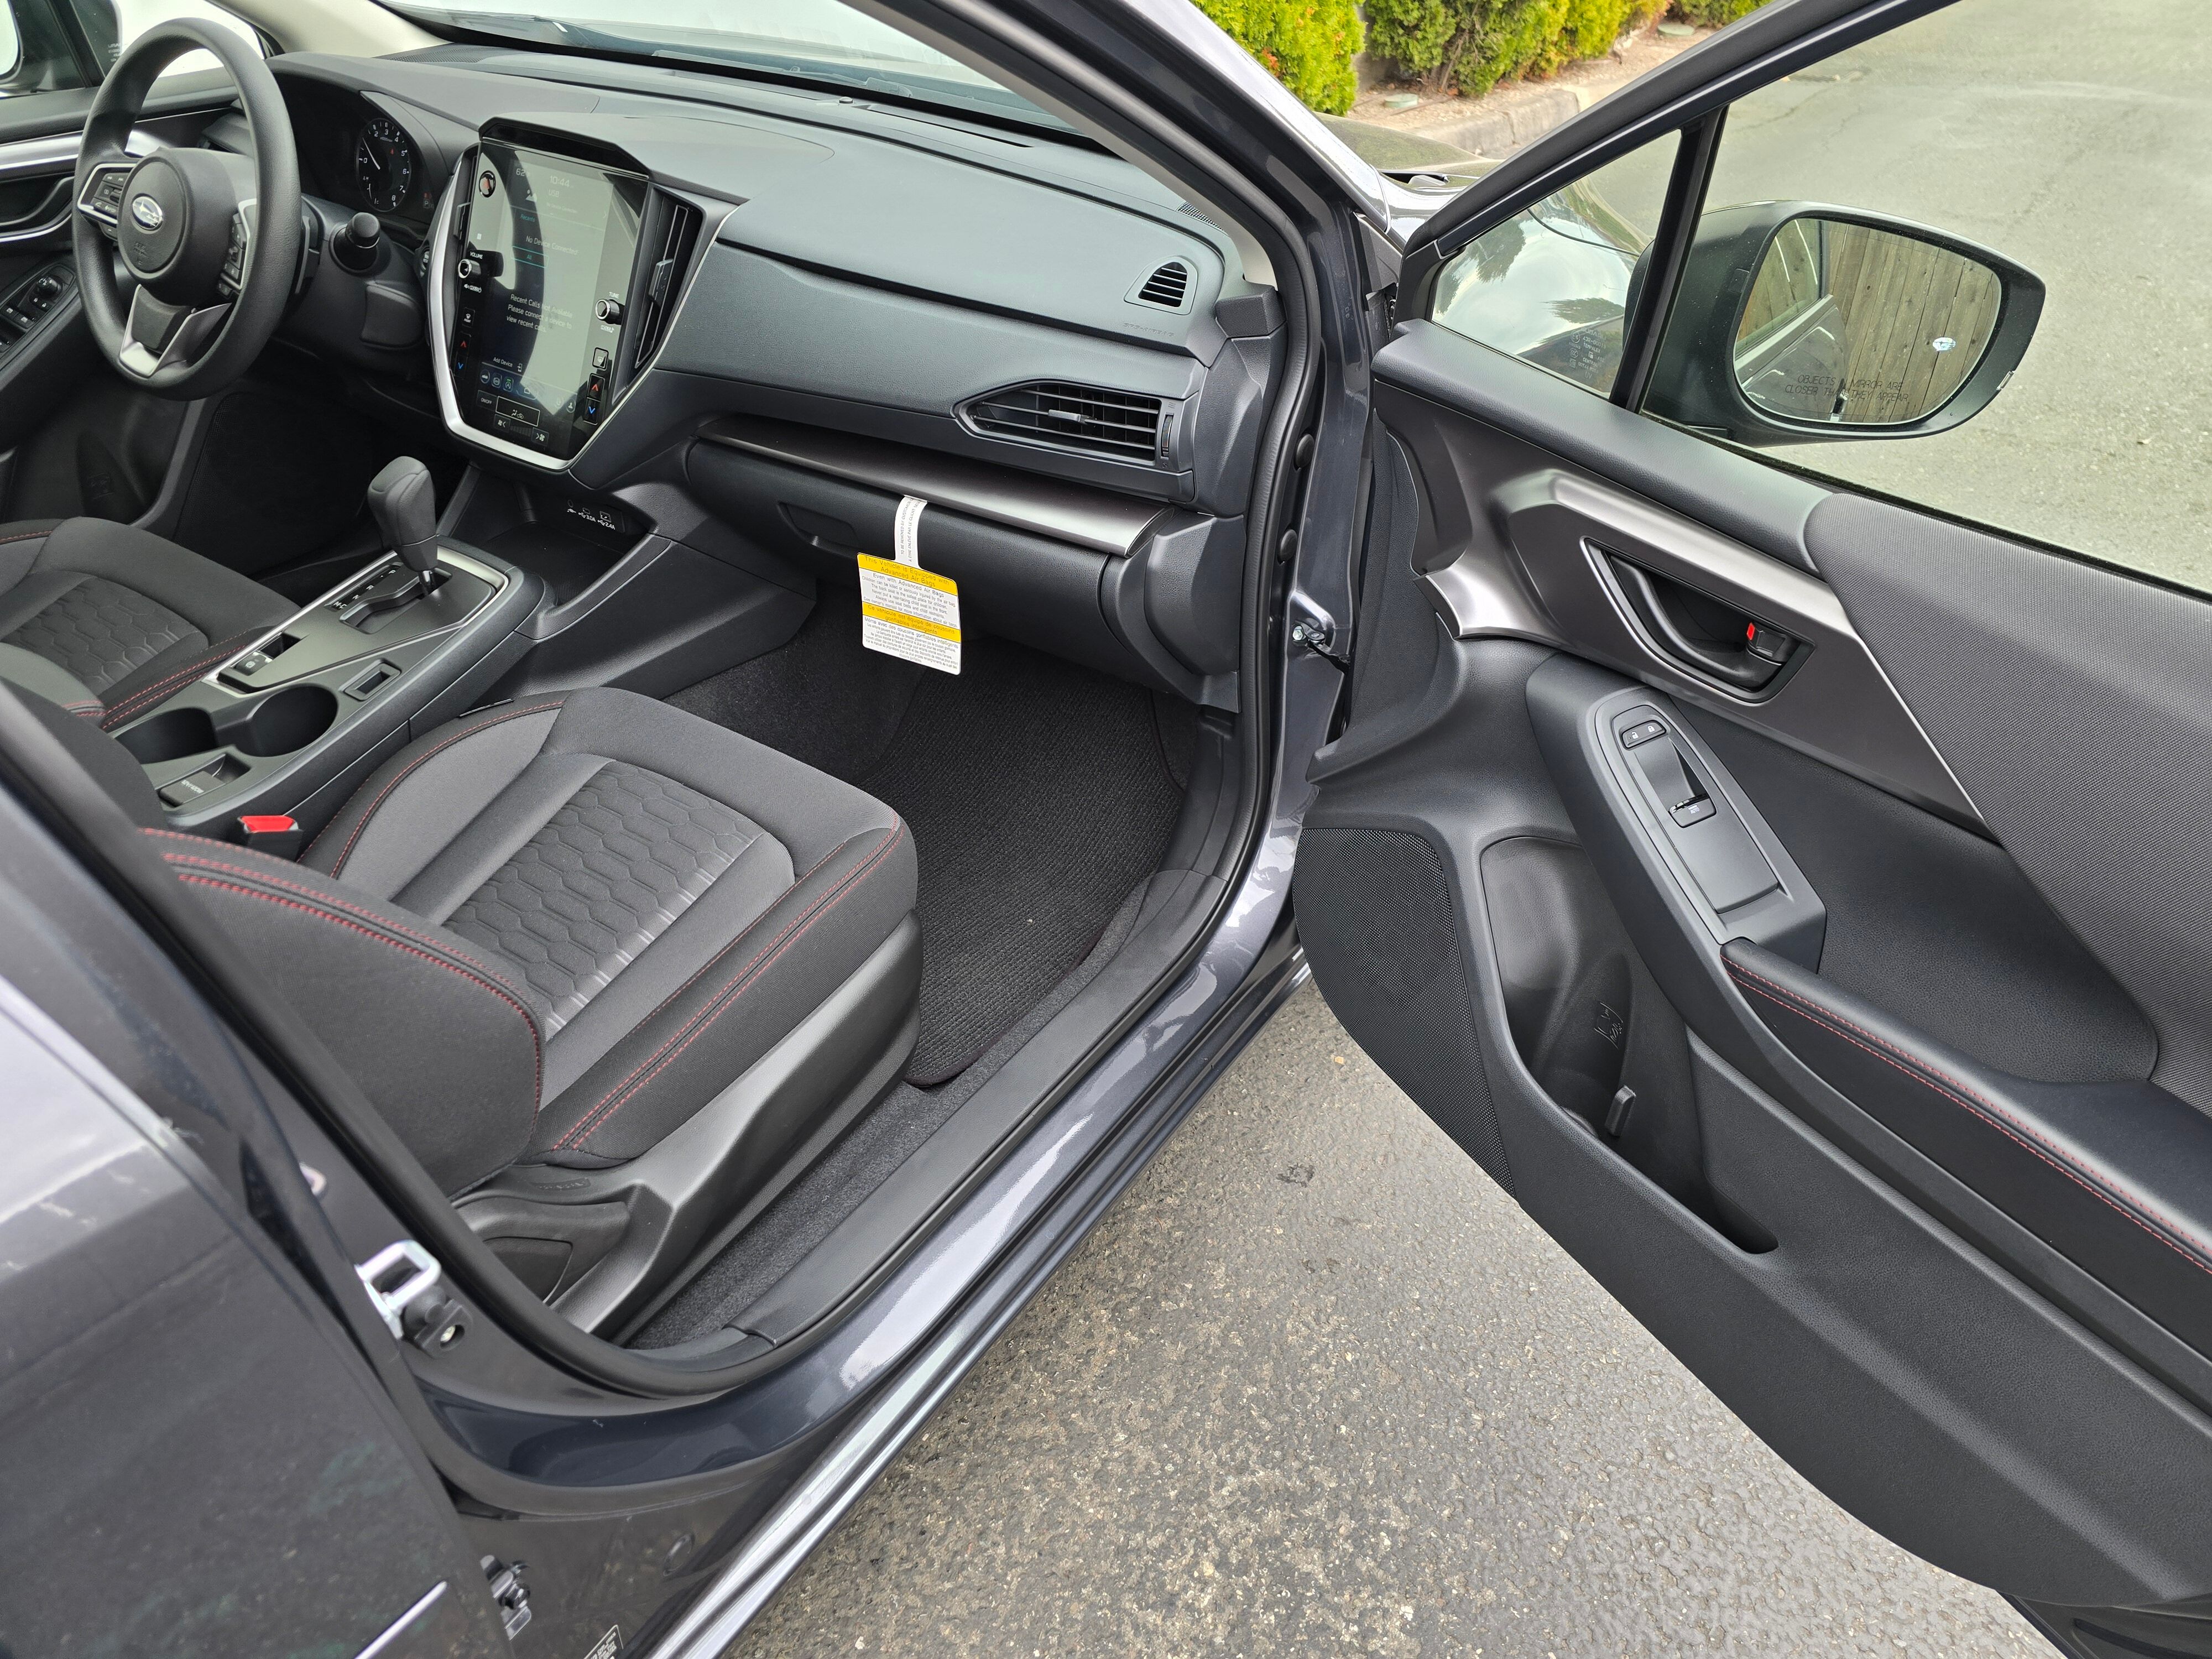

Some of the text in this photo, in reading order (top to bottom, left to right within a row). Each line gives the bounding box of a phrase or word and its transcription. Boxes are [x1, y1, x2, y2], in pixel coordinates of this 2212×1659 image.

[549, 175, 570, 187] 10:44
[525, 235, 533, 243] No
[534, 238, 551, 248] Device
[469, 251, 483, 259] VOLUME
[510, 294, 528, 305] Recent
[528, 299, 540, 309] Calls
[541, 303, 550, 312] Not
[507, 315, 517, 324] view
[518, 320, 534, 330] recent
[508, 304, 524, 315] Please
[525, 310, 544, 321] connect
[550, 316, 565, 327] device
[500, 359, 513, 368] Device
[1798, 374, 1836, 386] OBJECTS
[1885, 381, 1903, 390] ARE
[1785, 384, 1819, 395] CLOSER
[1851, 389, 1872, 399] THEY
[1875, 391, 1909, 403] APPEAR
[879, 560, 900, 570] Vehicle
[910, 569, 936, 581] Equipped
[881, 566, 908, 578] Advanced
[922, 578, 935, 588] Bags
[899, 580, 921, 591] Advanced
[932, 590, 944, 598] Bags
